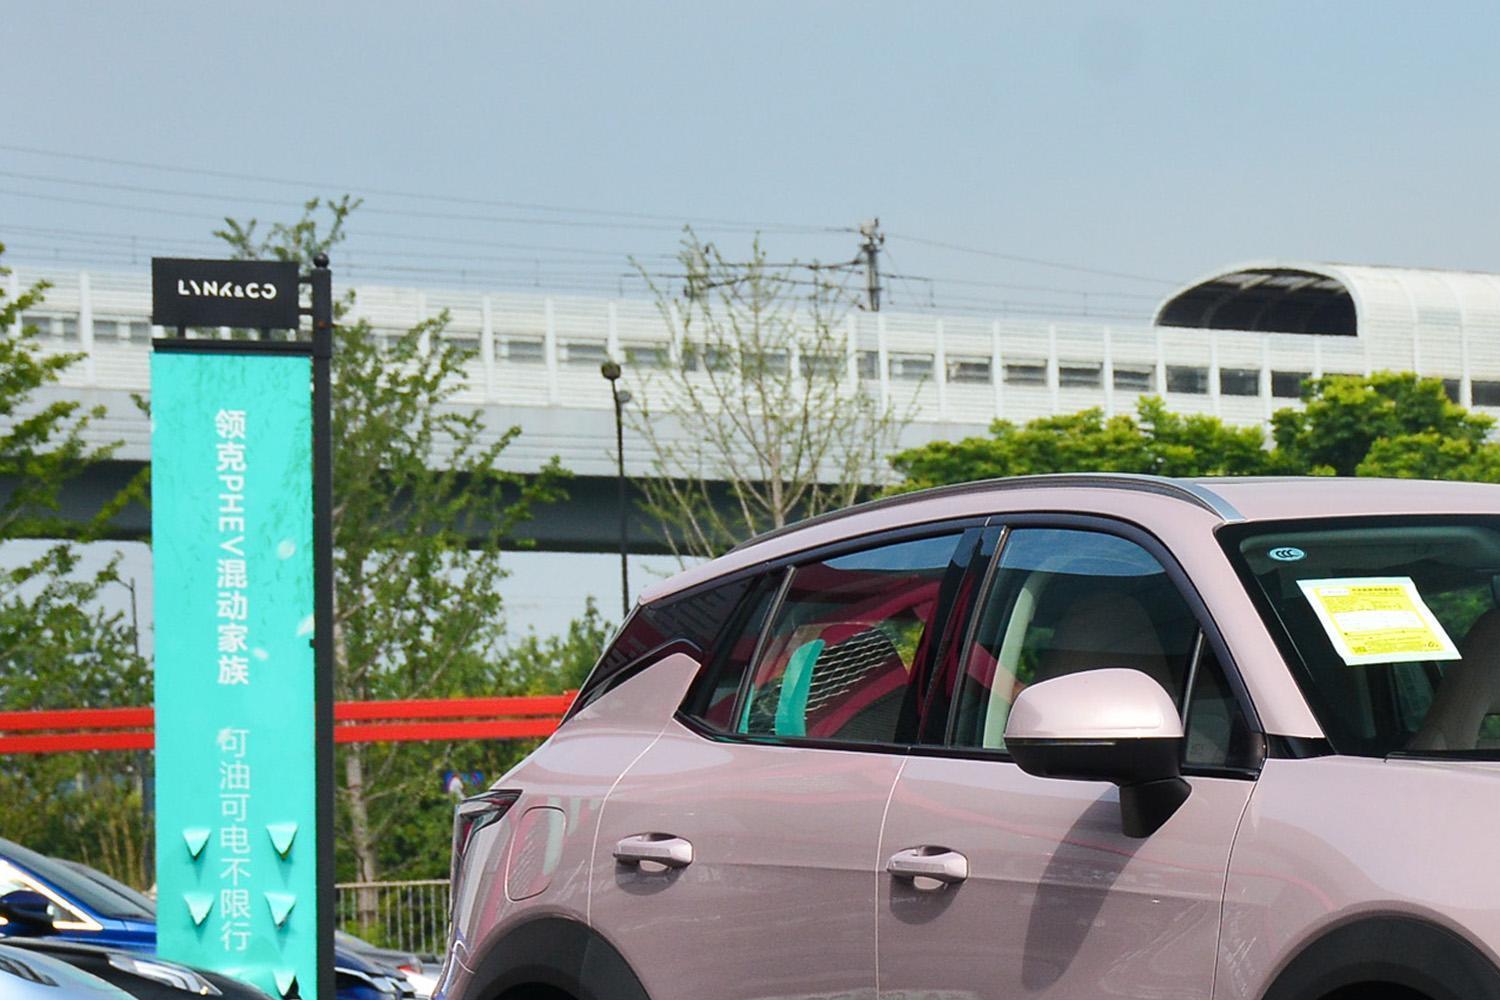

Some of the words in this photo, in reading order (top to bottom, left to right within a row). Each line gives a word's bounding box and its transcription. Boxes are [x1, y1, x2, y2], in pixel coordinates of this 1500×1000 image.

[178, 279, 278, 300] LYNK&CO
[214, 408, 249, 686] 领克PHEV混动家族
